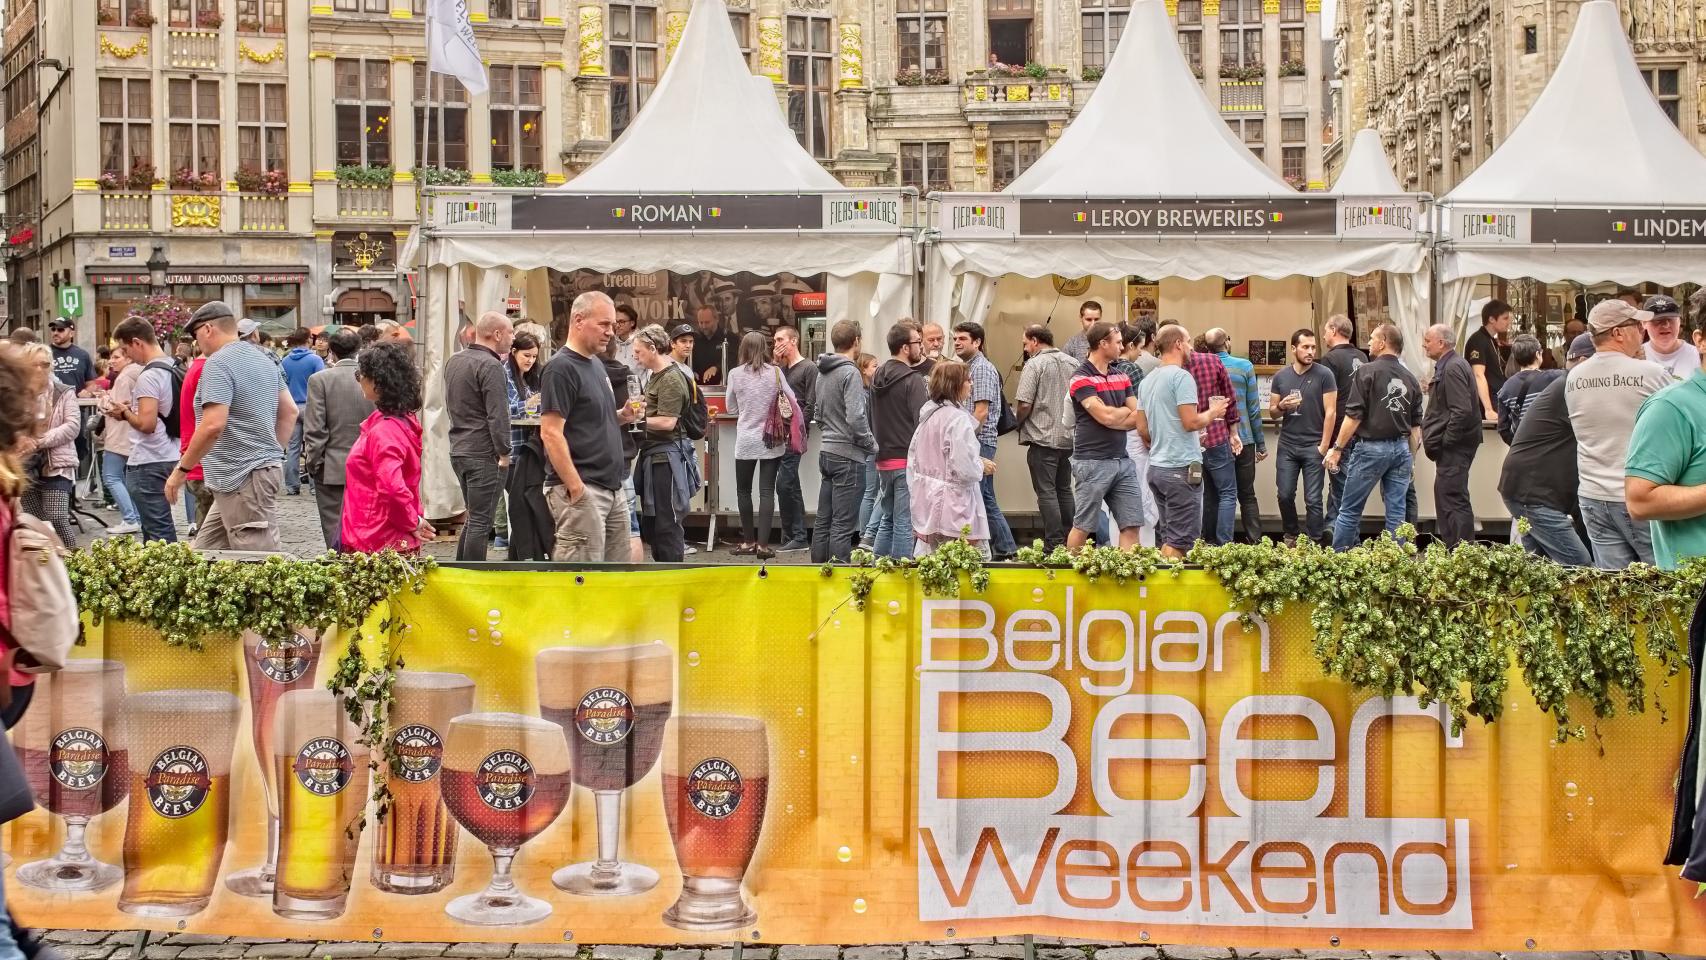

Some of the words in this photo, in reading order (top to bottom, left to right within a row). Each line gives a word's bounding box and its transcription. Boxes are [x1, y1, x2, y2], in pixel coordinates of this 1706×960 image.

[446, 202, 464, 226] FIER
[480, 202, 497, 227] BIER
[631, 204, 702, 222] ROMAN
[830, 201, 853, 225] FIERS
[953, 206, 971, 230] FIER
[987, 206, 1005, 230] BIER
[1091, 209, 1153, 227] LEROY
[1157, 209, 1265, 227] BREWERIES
[1345, 206, 1367, 231] FIERS
[1463, 214, 1481, 239] FIER
[1497, 214, 1516, 239] BIER
[1633, 218, 1706, 237] LINDEM
[199, 274, 244, 284] DIAMONDS
[602, 272, 657, 289] Creating
[631, 297, 686, 320] Work
[802, 297, 824, 306] Roman
[921, 586, 1270, 696] Belgian
[265, 666, 299, 681] BEER
[582, 690, 628, 707] BELGIAN
[585, 707, 626, 718] Paradise
[55, 730, 103, 749] BELGIAN
[396, 727, 439, 746] BELGIAN
[585, 727, 622, 742] BEER
[302, 740, 347, 758] BELGIAN
[918, 671, 1464, 818] Beer
[58, 749, 100, 761] Paradise
[156, 750, 205, 772] BELGIAN
[305, 758, 344, 769] Paradise
[483, 753, 530, 772] BELGIAN
[57, 770, 96, 787] BEER
[158, 772, 201, 785] Paradise
[485, 772, 528, 783] Paradise
[694, 761, 737, 781] BELGIAN
[304, 778, 341, 794] BEER
[696, 779, 735, 791] Paradise
[154, 795, 194, 815] BEER
[484, 793, 523, 809] BEER
[697, 799, 731, 816] BEER
[918, 818, 1458, 916] Weekend
